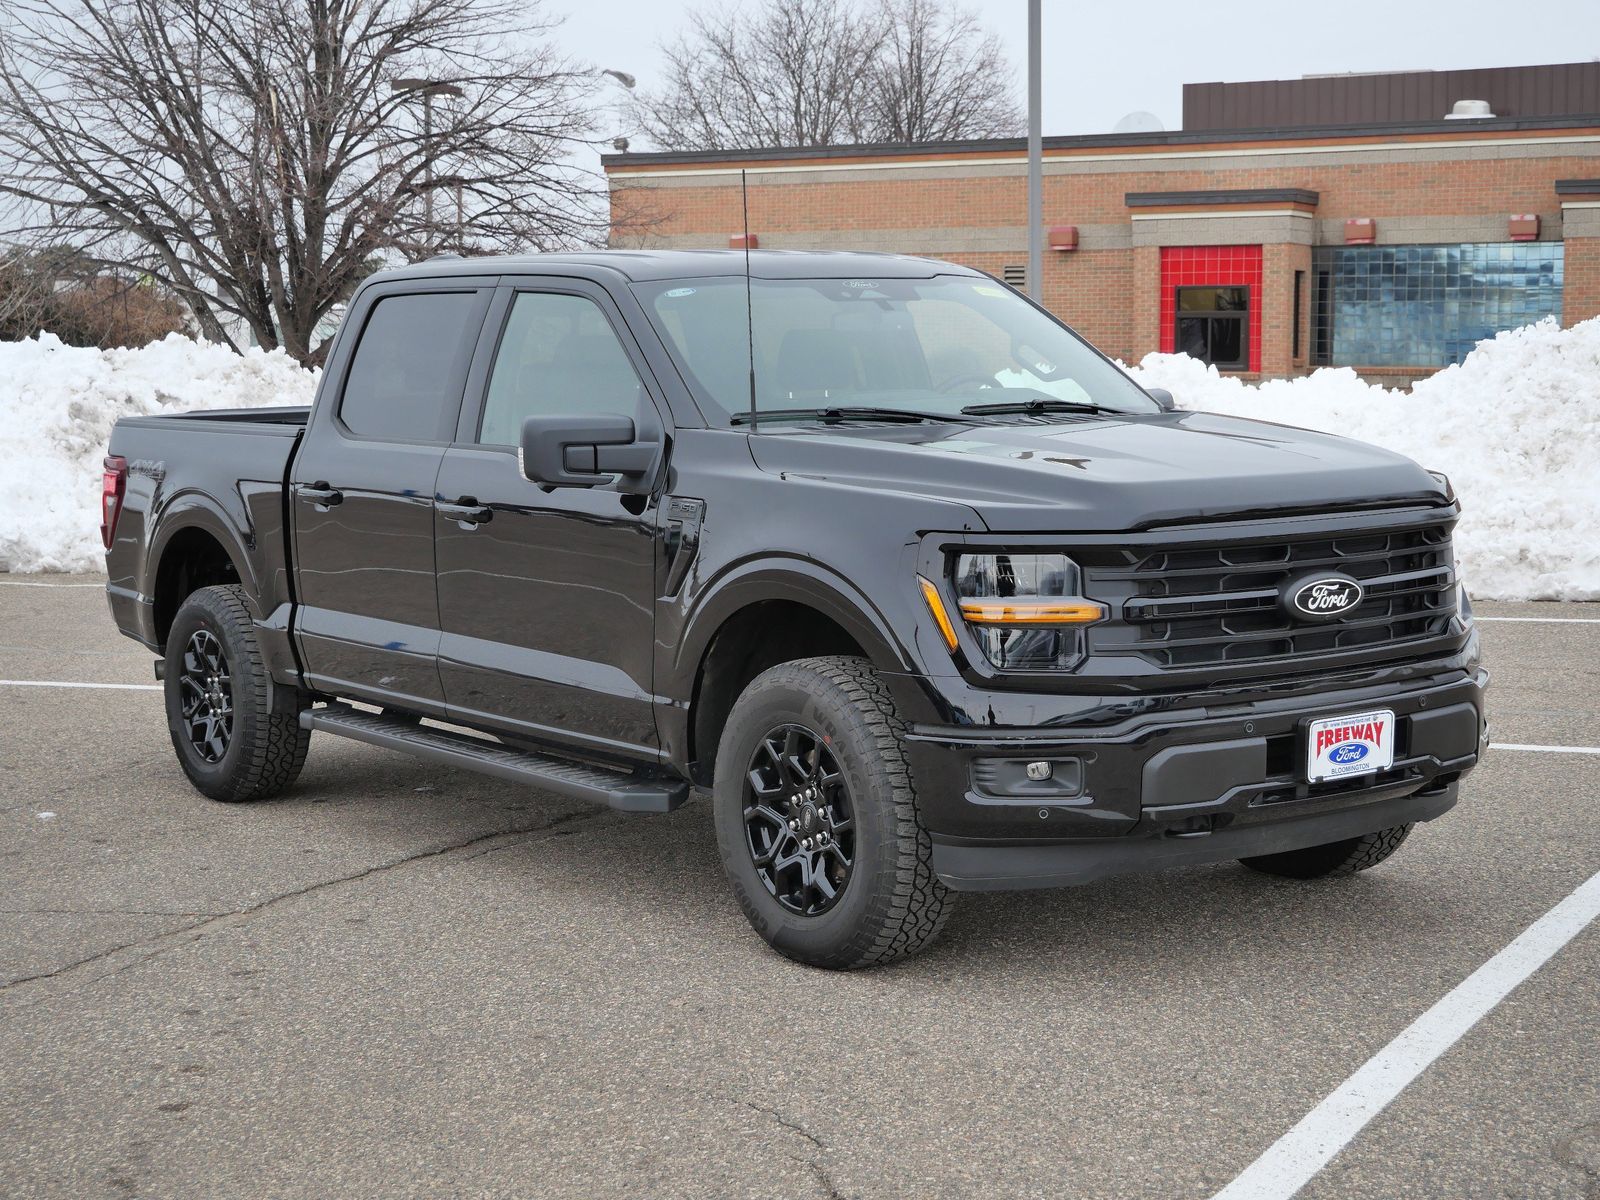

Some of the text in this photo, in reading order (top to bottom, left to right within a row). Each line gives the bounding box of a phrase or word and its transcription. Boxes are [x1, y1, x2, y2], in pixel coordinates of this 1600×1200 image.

[1308, 584, 1349, 610] Ford
[1316, 721, 1384, 760] FREEWAY
[1336, 745, 1361, 761] Ford
[1331, 763, 1369, 774] BLOOMINGTON
